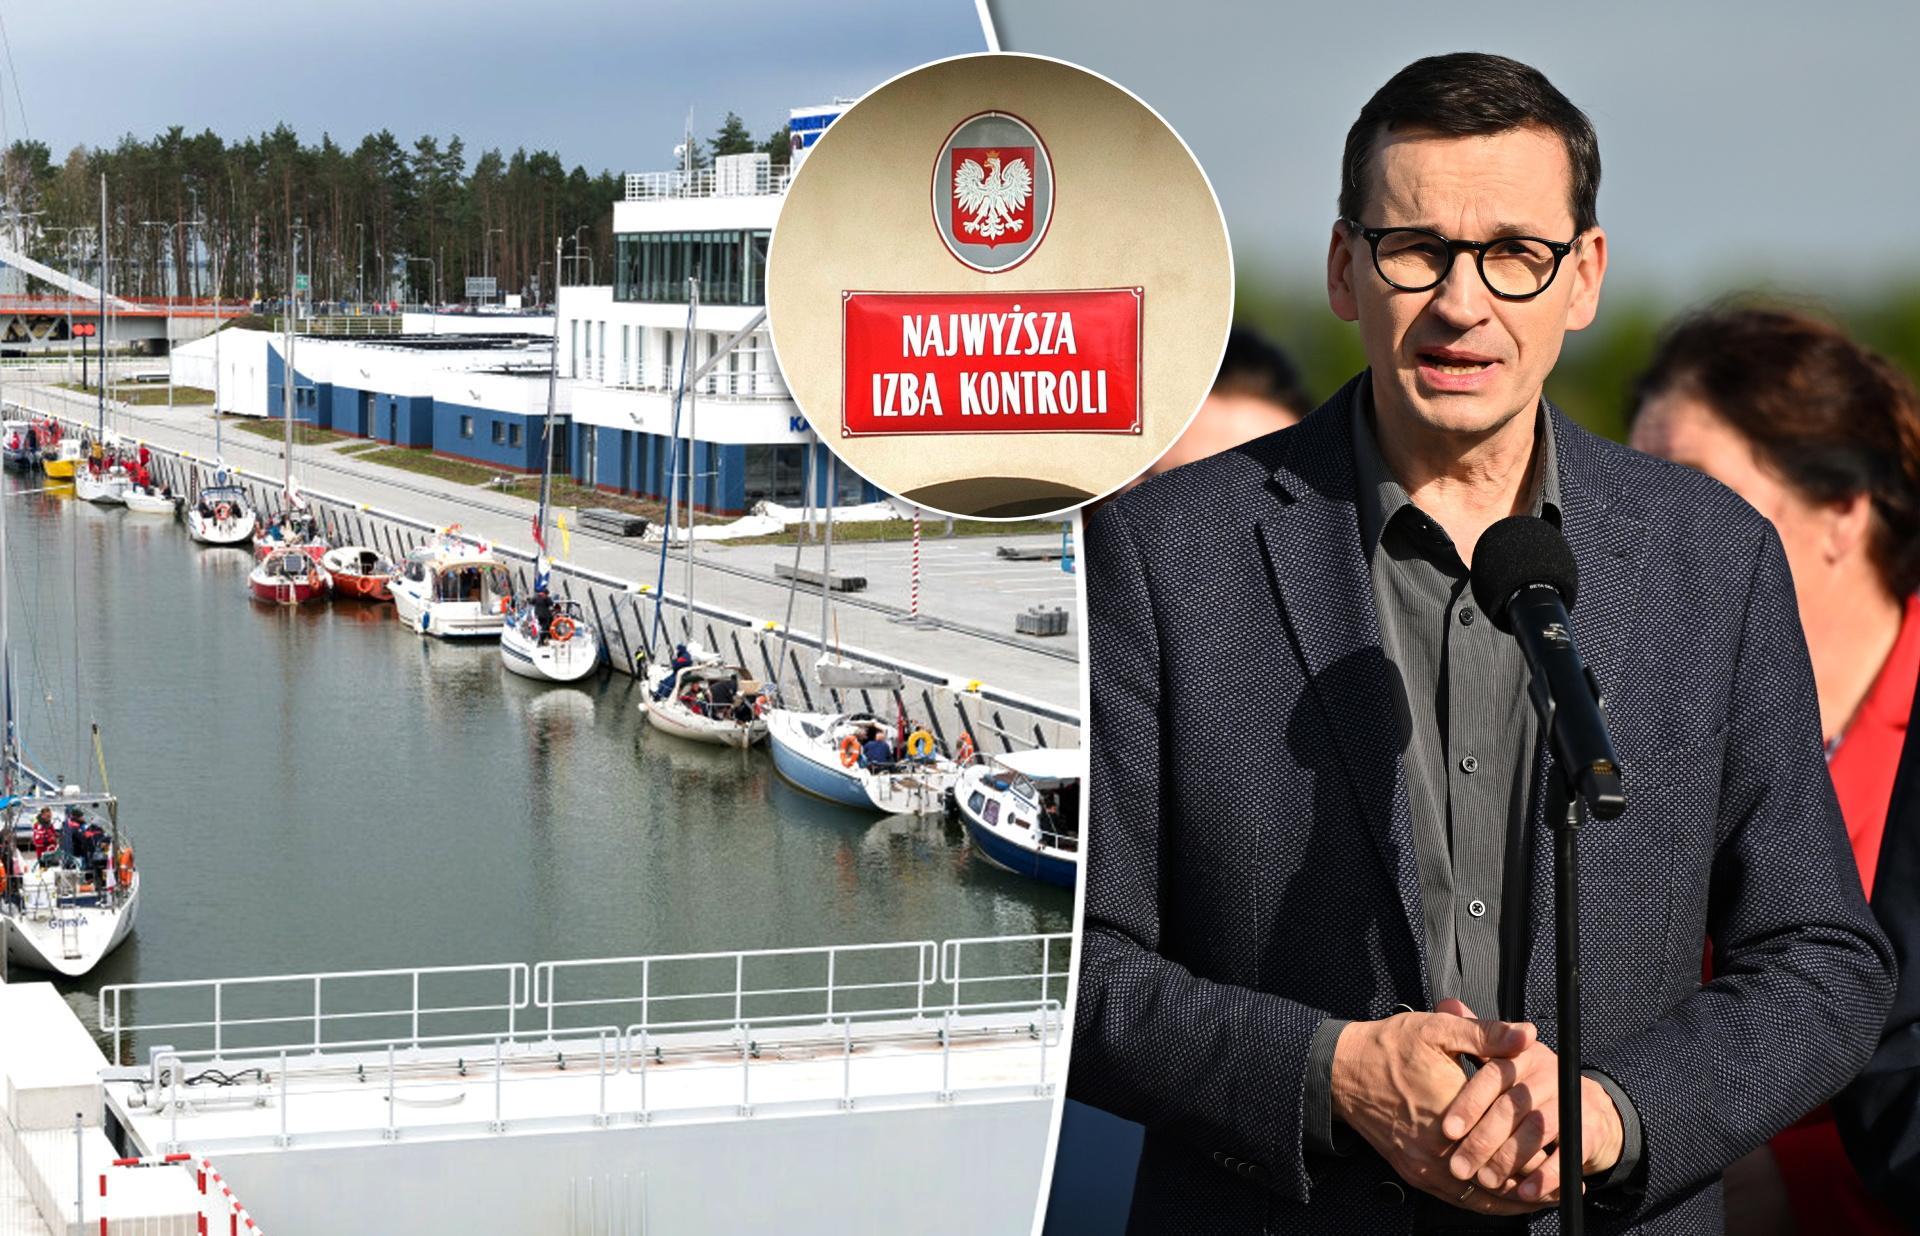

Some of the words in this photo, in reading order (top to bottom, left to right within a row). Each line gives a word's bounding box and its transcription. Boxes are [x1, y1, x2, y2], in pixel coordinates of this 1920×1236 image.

[903, 304, 1077, 357] NAJWYŻSZA
[872, 372, 943, 417] IZBA
[960, 370, 1107, 416] KONTROLI
